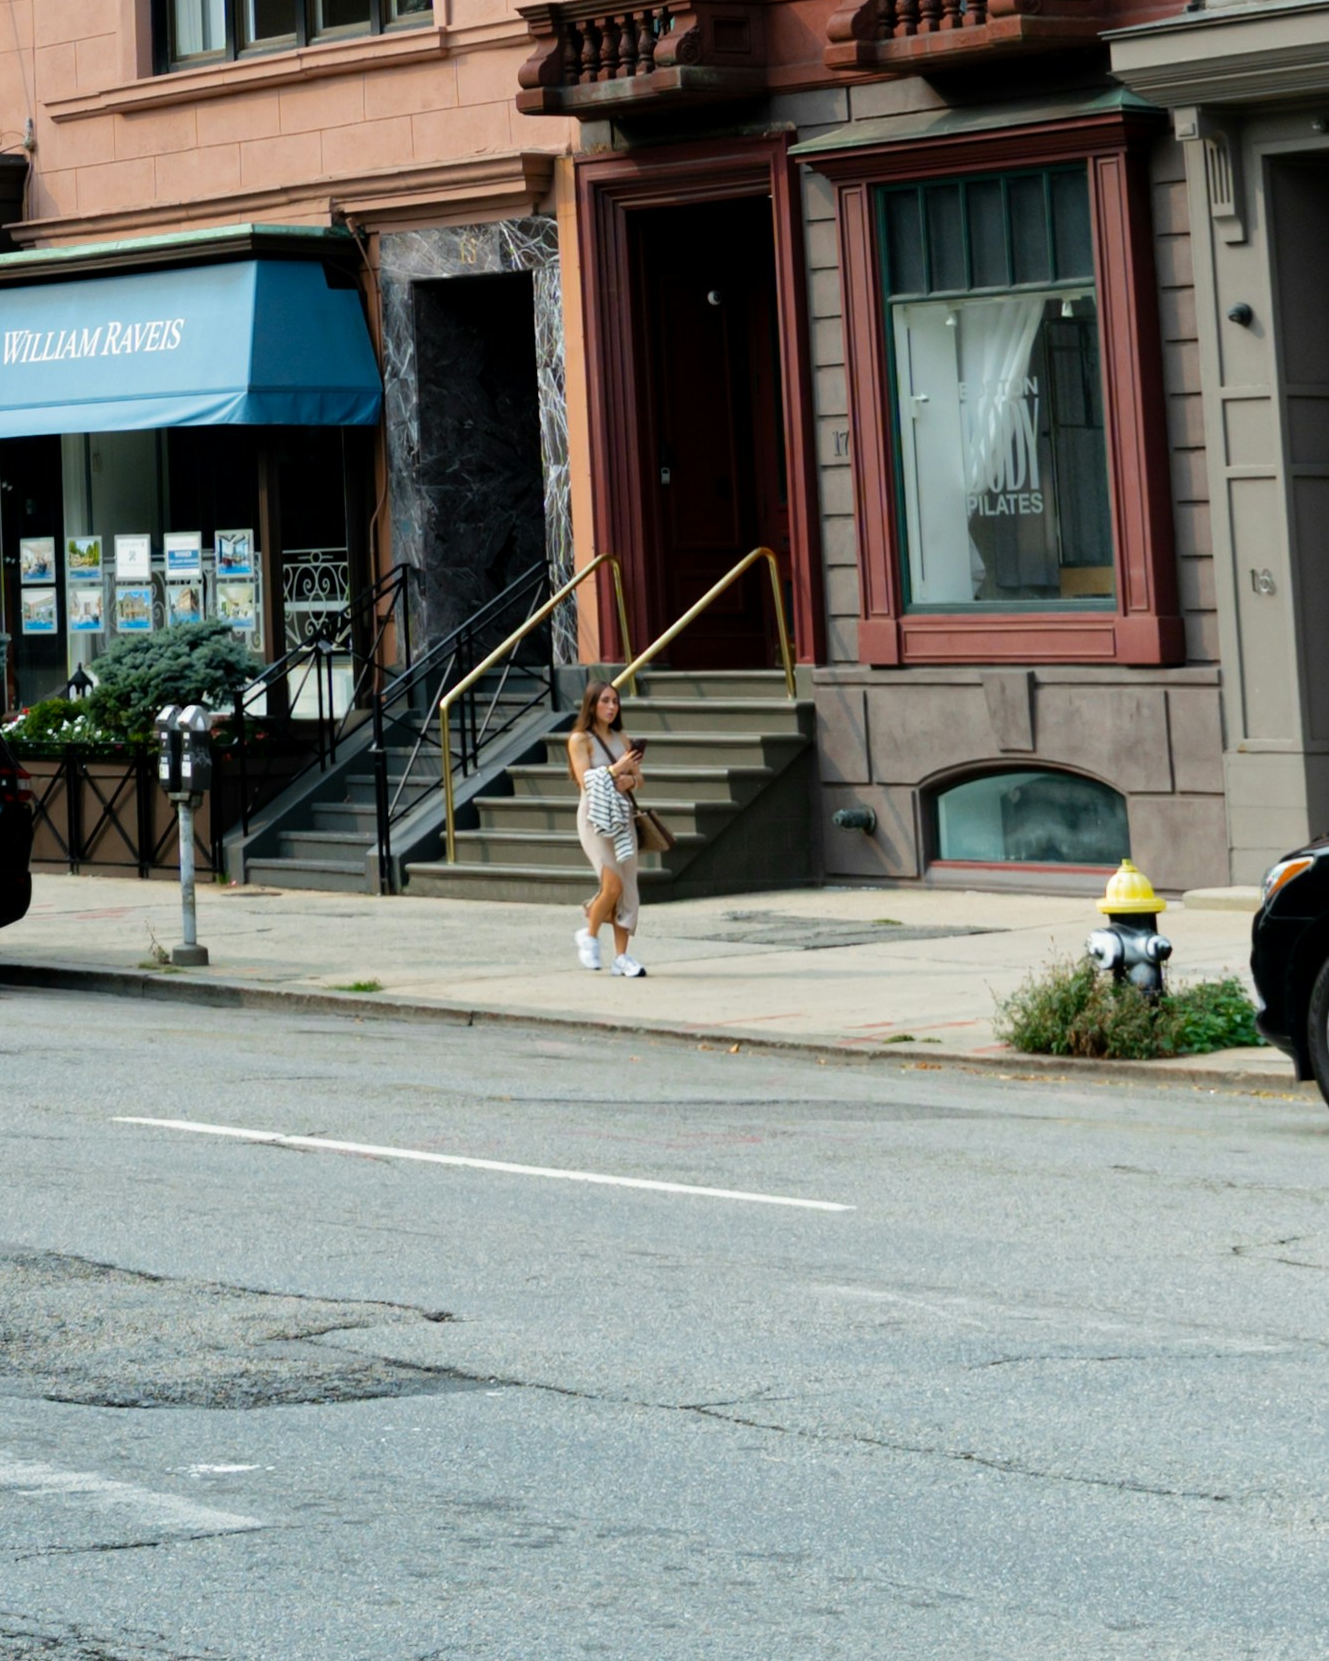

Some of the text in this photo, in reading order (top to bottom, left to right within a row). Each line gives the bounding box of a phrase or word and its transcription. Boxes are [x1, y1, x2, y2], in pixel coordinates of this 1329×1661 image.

[3, 318, 186, 366] WILLIAM RAVEIS
[832, 430, 850, 457] 17
[967, 493, 1044, 516] PILATES
